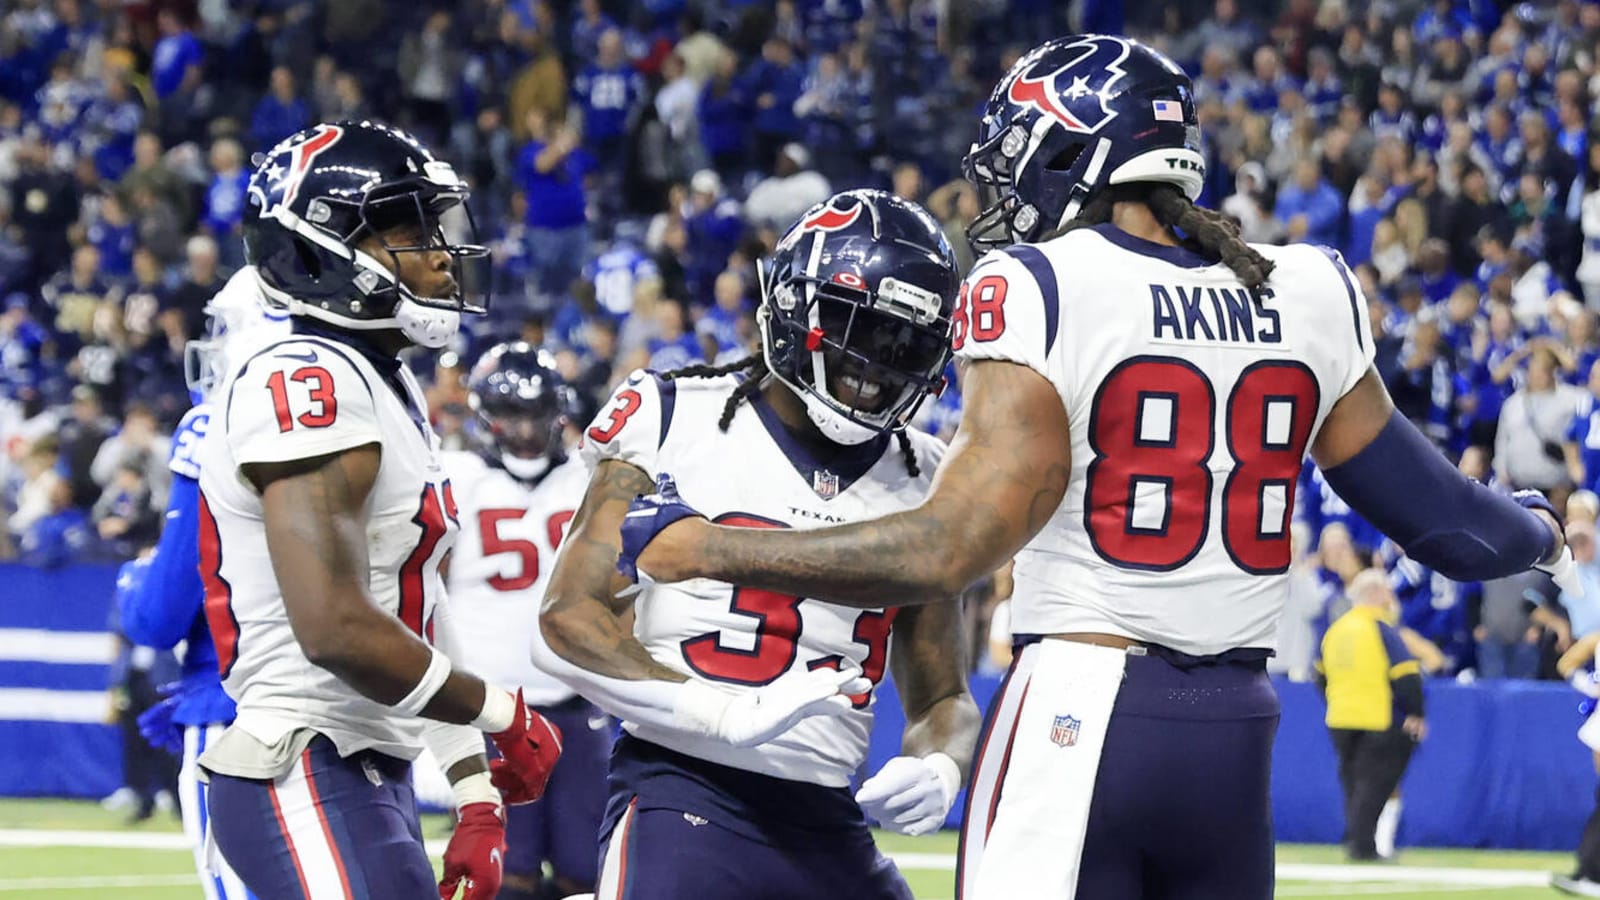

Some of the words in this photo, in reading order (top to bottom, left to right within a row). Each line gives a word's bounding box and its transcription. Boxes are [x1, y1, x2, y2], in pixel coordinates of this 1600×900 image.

[1149, 284, 1282, 343] AKINS
[265, 366, 338, 434] 13
[578, 389, 642, 449] 3
[1083, 354, 1321, 576] 88
